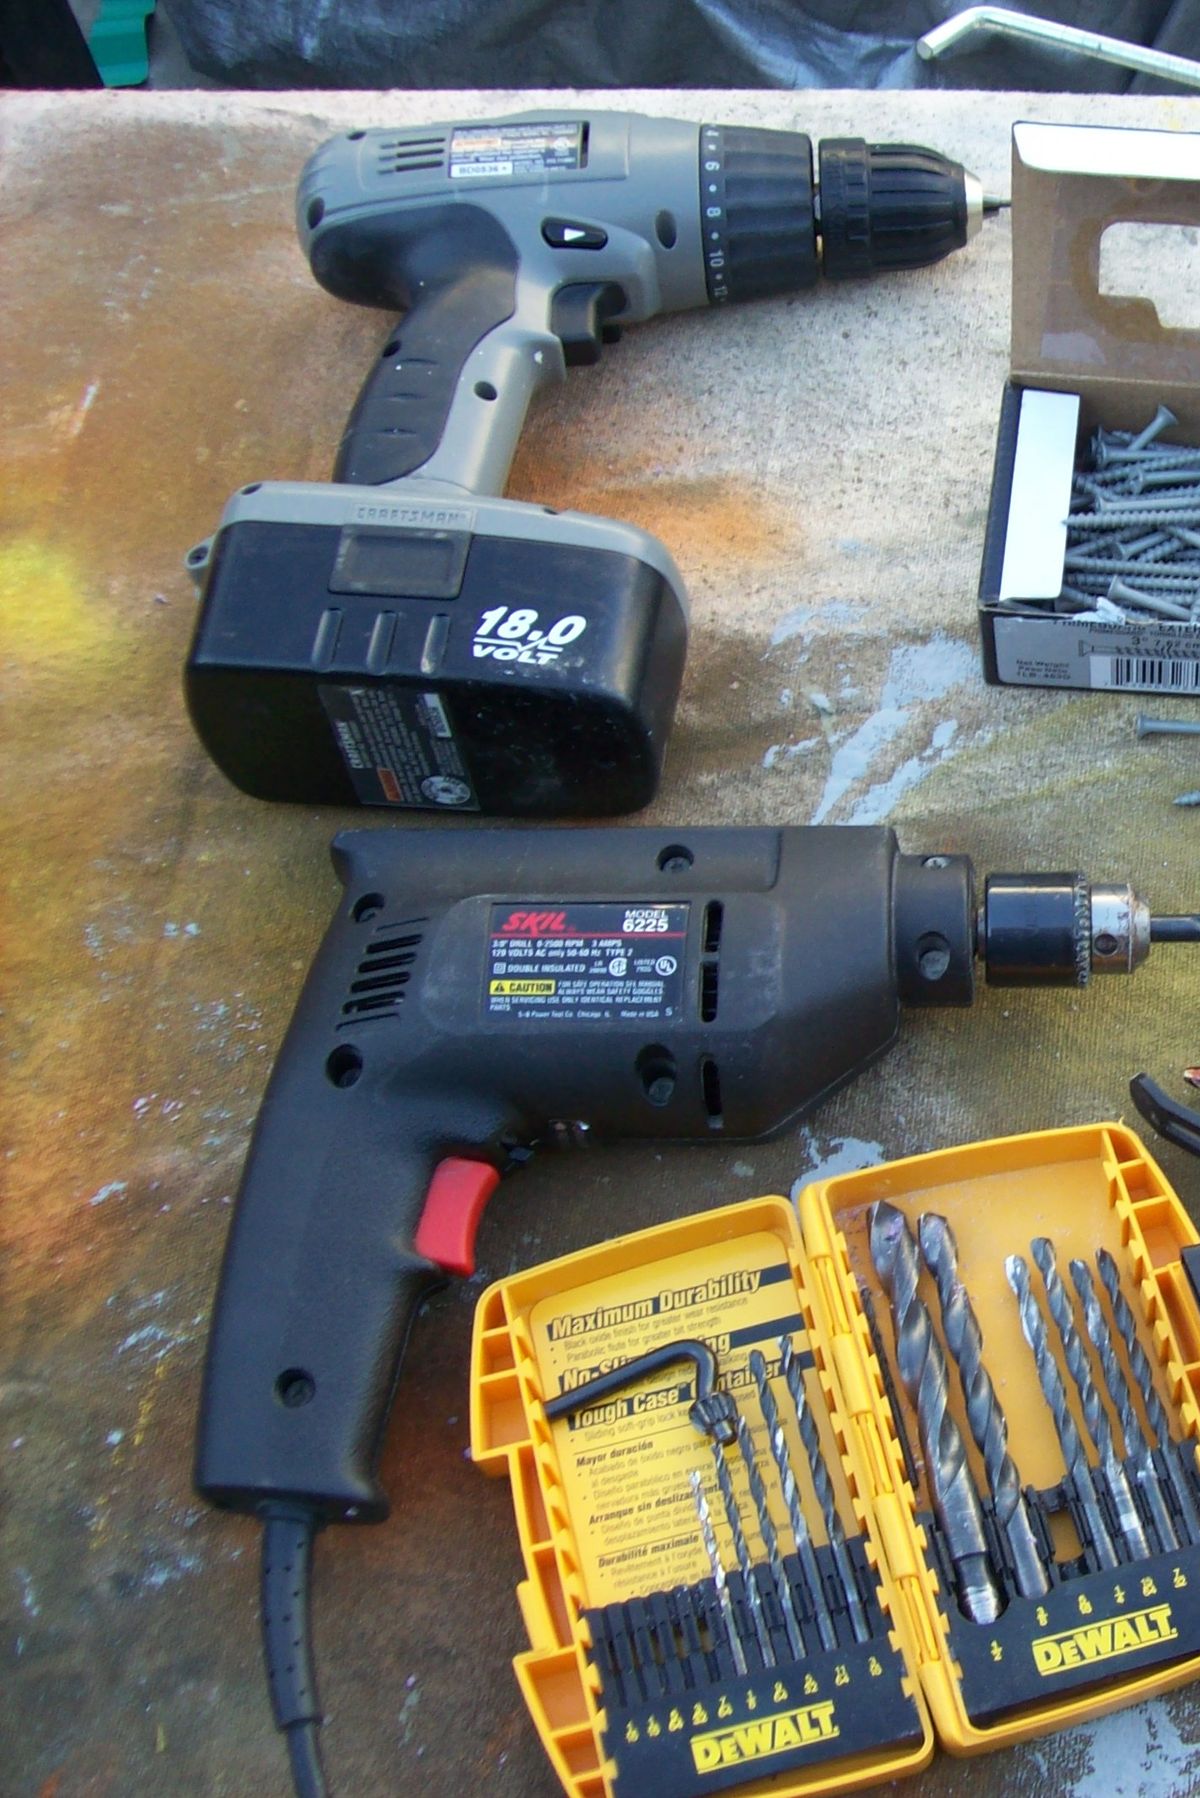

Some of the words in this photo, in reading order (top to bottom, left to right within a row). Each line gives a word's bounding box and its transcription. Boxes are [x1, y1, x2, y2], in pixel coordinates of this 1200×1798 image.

[705, 161, 719, 170] 6
[707, 207, 721, 217] 8
[709, 250, 724, 267] 10
[476, 606, 587, 645] 18.0
[473, 645, 559, 665] VOLT
[502, 911, 568, 937] SKIL
[622, 919, 668, 932] 6225
[625, 910, 668, 919] MODEL
[508, 949, 533, 957] VOLTS
[534, 949, 545, 957] AC
[510, 940, 532, 948] DRILL
[542, 964, 585, 972] INSULATED
[509, 983, 552, 992] CAUTION
[551, 1299, 653, 1341] Maximum
[659, 1270, 761, 1311] Durability
[563, 1337, 586, 1351] Black
[589, 1331, 612, 1344] oxide
[612, 1325, 637, 1338] finish
[638, 1322, 650, 1332] for
[652, 1314, 681, 1330] greater
[684, 1308, 704, 1320] wear
[706, 1296, 748, 1314] resistance
[566, 1346, 606, 1363] Parabolic
[607, 1341, 626, 1352] flute
[627, 1337, 640, 1347] for
[642, 1329, 672, 1346] greater
[673, 1325, 685, 1336] bit
[686, 1316, 722, 1332] strength
[572, 1402, 628, 1431] Tough
[584, 1427, 616, 1442] Sliding
[617, 1416, 656, 1434] soft-grip
[657, 1411, 676, 1422] lock
[576, 1453, 607, 1468] Mayor
[610, 1440, 654, 1459] duración
[627, 1458, 638, 1466] de
[666, 1443, 692, 1456] negro
[593, 1485, 624, 1500] Diseño
[625, 1473, 670, 1492] parabólico
[672, 1470, 683, 1479] en
[600, 1470, 639, 1486] desgaste
[589, 1507, 634, 1526] Arranque
[637, 1502, 652, 1513] sin
[600, 1520, 631, 1534] Diseño
[633, 1517, 644, 1526] de
[646, 1510, 671, 1524] punta
[604, 1523, 668, 1546] desplazamiento
[598, 1546, 648, 1568] Durabilité
[651, 1534, 699, 1554] maximale
